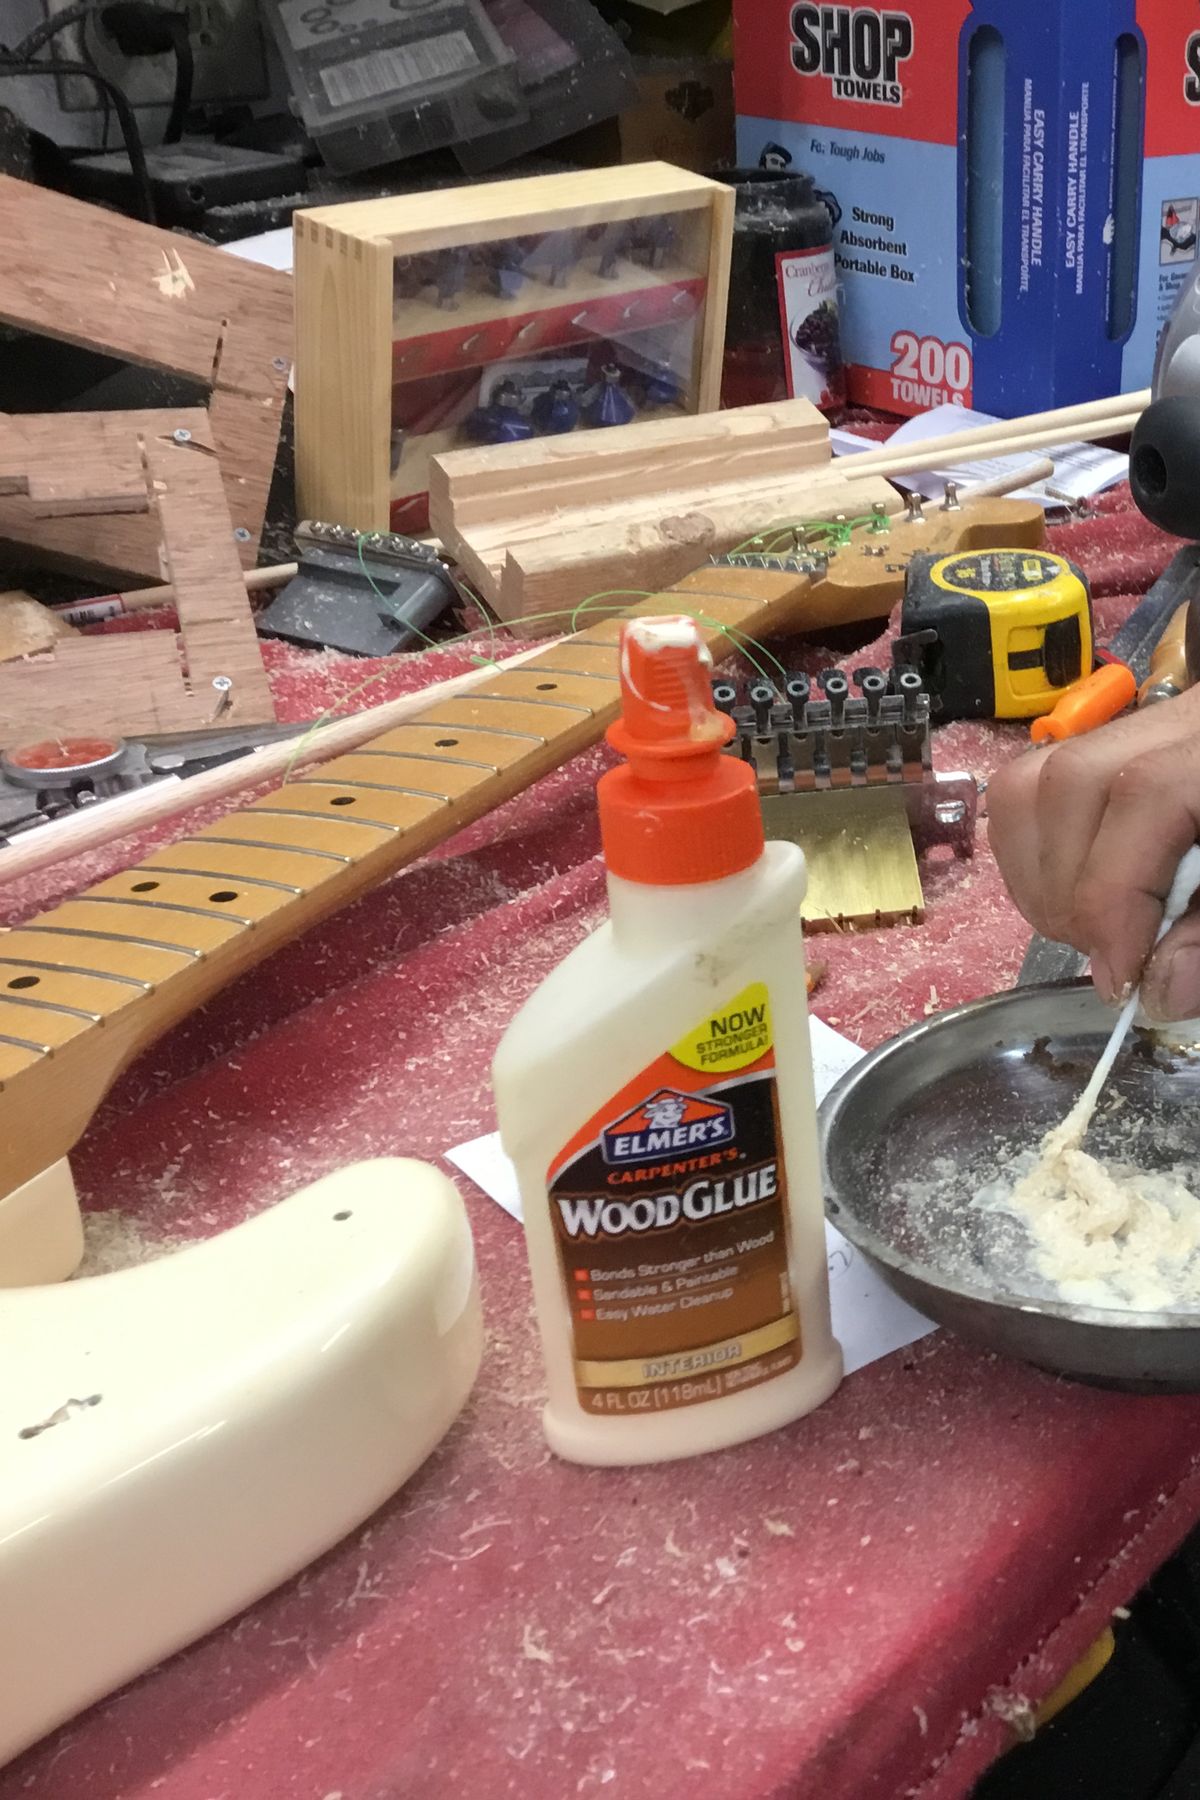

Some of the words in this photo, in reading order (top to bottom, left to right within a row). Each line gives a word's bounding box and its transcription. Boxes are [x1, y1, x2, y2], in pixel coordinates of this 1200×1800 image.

[792, 5, 913, 82] SHOP
[834, 78, 901, 104] TOWELS
[1033, 108, 1046, 149] EASY
[1067, 111, 1080, 173] HANDLE
[829, 141, 860, 161] Tough
[861, 147, 886, 164] Jobs
[1032, 150, 1045, 204] CARRY
[852, 206, 895, 232] Strong
[1066, 176, 1078, 228] CARRY
[840, 230, 908, 256] Absorbent
[1030, 205, 1043, 267] HANDLE
[1065, 230, 1076, 268] EASY
[834, 253, 887, 277] Portable
[890, 263, 916, 283] Box
[892, 333, 970, 391] 200
[890, 377, 965, 409] TOWELS
[696, 1022, 768, 1054] STRONGER
[710, 1003, 766, 1038] NOW
[613, 1115, 727, 1157] ELMER'S
[607, 1146, 739, 1185] CARPENTER'S
[590, 1268, 636, 1283] Bonds
[638, 1255, 701, 1277] Stronger
[703, 1246, 735, 1264] than
[736, 1230, 775, 1254] Wood
[593, 1284, 659, 1302] Sandable
[661, 1280, 673, 1293] &
[675, 1265, 740, 1290] Paintable
[595, 1307, 629, 1322] Easy
[631, 1300, 677, 1317] Water
[679, 1286, 734, 1309] Cleanup
[642, 1342, 743, 1378] INTERIOR
[591, 1393, 604, 1408] 4
[606, 1392, 626, 1409] FL
[627, 1390, 651, 1408] OZ
